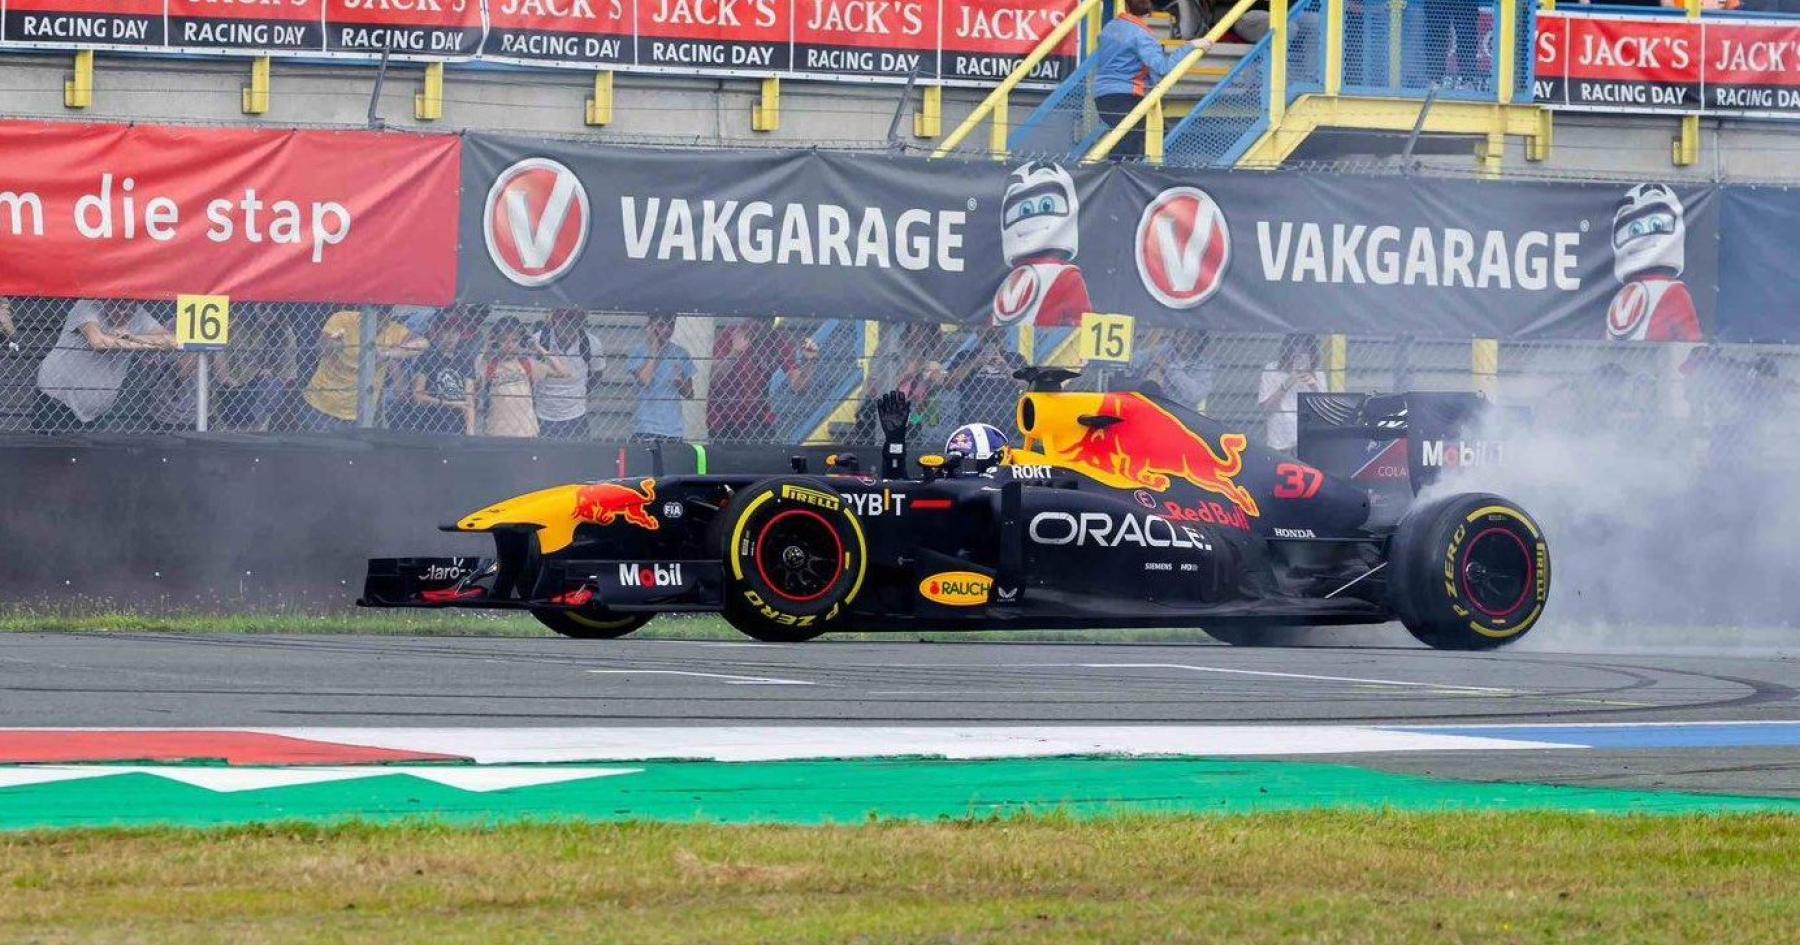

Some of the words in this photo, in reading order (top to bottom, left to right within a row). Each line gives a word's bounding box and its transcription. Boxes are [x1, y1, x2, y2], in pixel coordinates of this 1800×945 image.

[24, 16, 107, 38] RACING
[112, 20, 148, 40] DAY
[807, 0, 923, 36] JACK'S
[184, 22, 268, 43] RACING
[273, 26, 306, 45] DAY
[341, 28, 424, 49] RACING
[431, 31, 463, 51] DAY
[500, 34, 578, 56] RACING
[585, 38, 620, 58] DAY
[653, 42, 725, 63] RACING
[732, 46, 774, 65] DAY
[807, 49, 874, 70] RACING
[880, 53, 920, 72] DAY
[1579, 34, 1689, 70] JACK'S
[1716, 39, 1800, 72] JACK'
[1581, 82, 1646, 104] RACING
[1652, 86, 1687, 105] DAY
[1716, 88, 1773, 107] RACING
[73, 173, 179, 241] die
[206, 188, 352, 263] stap
[620, 195, 967, 273] VAKGARAGE
[1256, 221, 1582, 291] VAKGARAGE
[183, 303, 221, 340] 16
[1090, 321, 1125, 358] 15
[1012, 465, 1053, 480] ROKT
[1274, 463, 1325, 499] 37
[1377, 466, 1410, 478] COLA
[781, 484, 840, 511] PIRELLI
[1160, 499, 1215, 523] Red
[1029, 511, 1212, 551] ORACLE
[1274, 527, 1316, 538] HONDA
[619, 563, 683, 589] Mobil
[942, 581, 991, 595] RAUCH
[744, 590, 817, 626] ZERO
